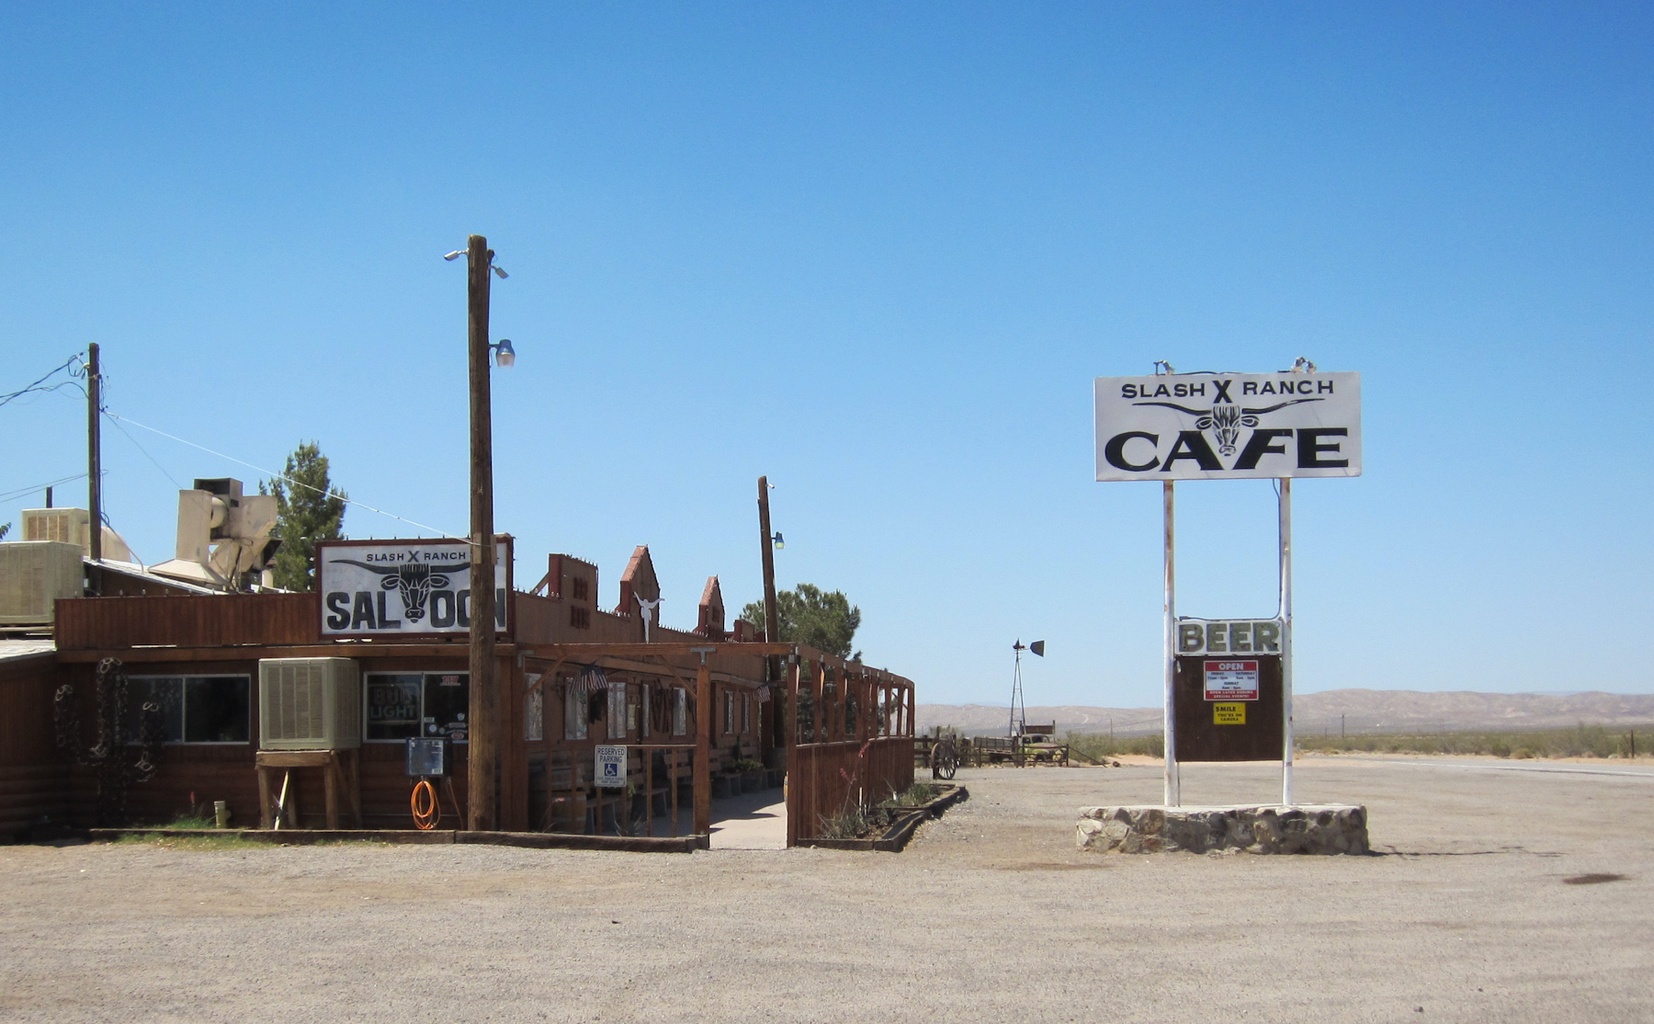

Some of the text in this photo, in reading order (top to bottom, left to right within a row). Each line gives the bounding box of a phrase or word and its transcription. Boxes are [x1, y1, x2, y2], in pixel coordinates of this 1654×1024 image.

[1121, 379, 1334, 403] SLASH X RANCH
[1104, 427, 1349, 472] CAFE
[366, 550, 466, 562] SLASH X RANCH
[1178, 622, 1280, 652] BEER
[1218, 662, 1244, 670] OPEN
[598, 747, 625, 755] RESERVED
[600, 755, 622, 763] PARKING
